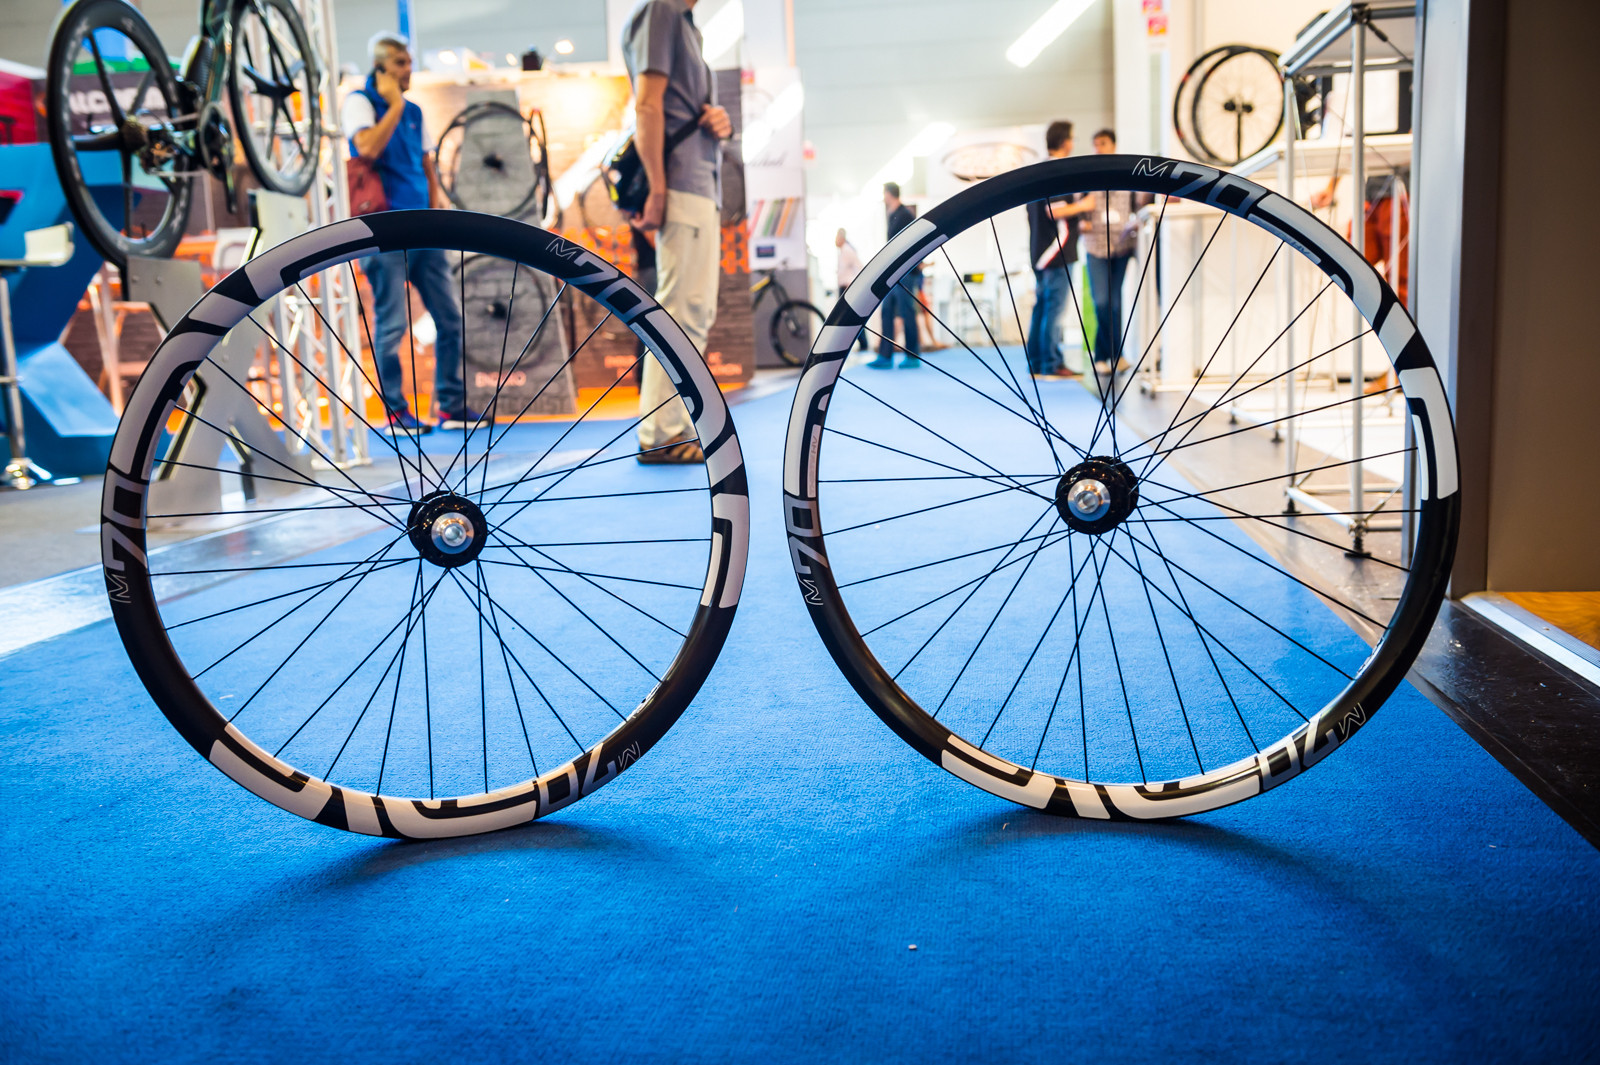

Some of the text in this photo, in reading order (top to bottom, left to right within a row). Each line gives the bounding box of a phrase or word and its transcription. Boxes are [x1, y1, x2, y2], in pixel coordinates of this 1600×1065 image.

[1132, 157, 1268, 219] M70
[546, 236, 658, 324] M70
[101, 468, 150, 604] M70
[783, 493, 829, 605] M70
